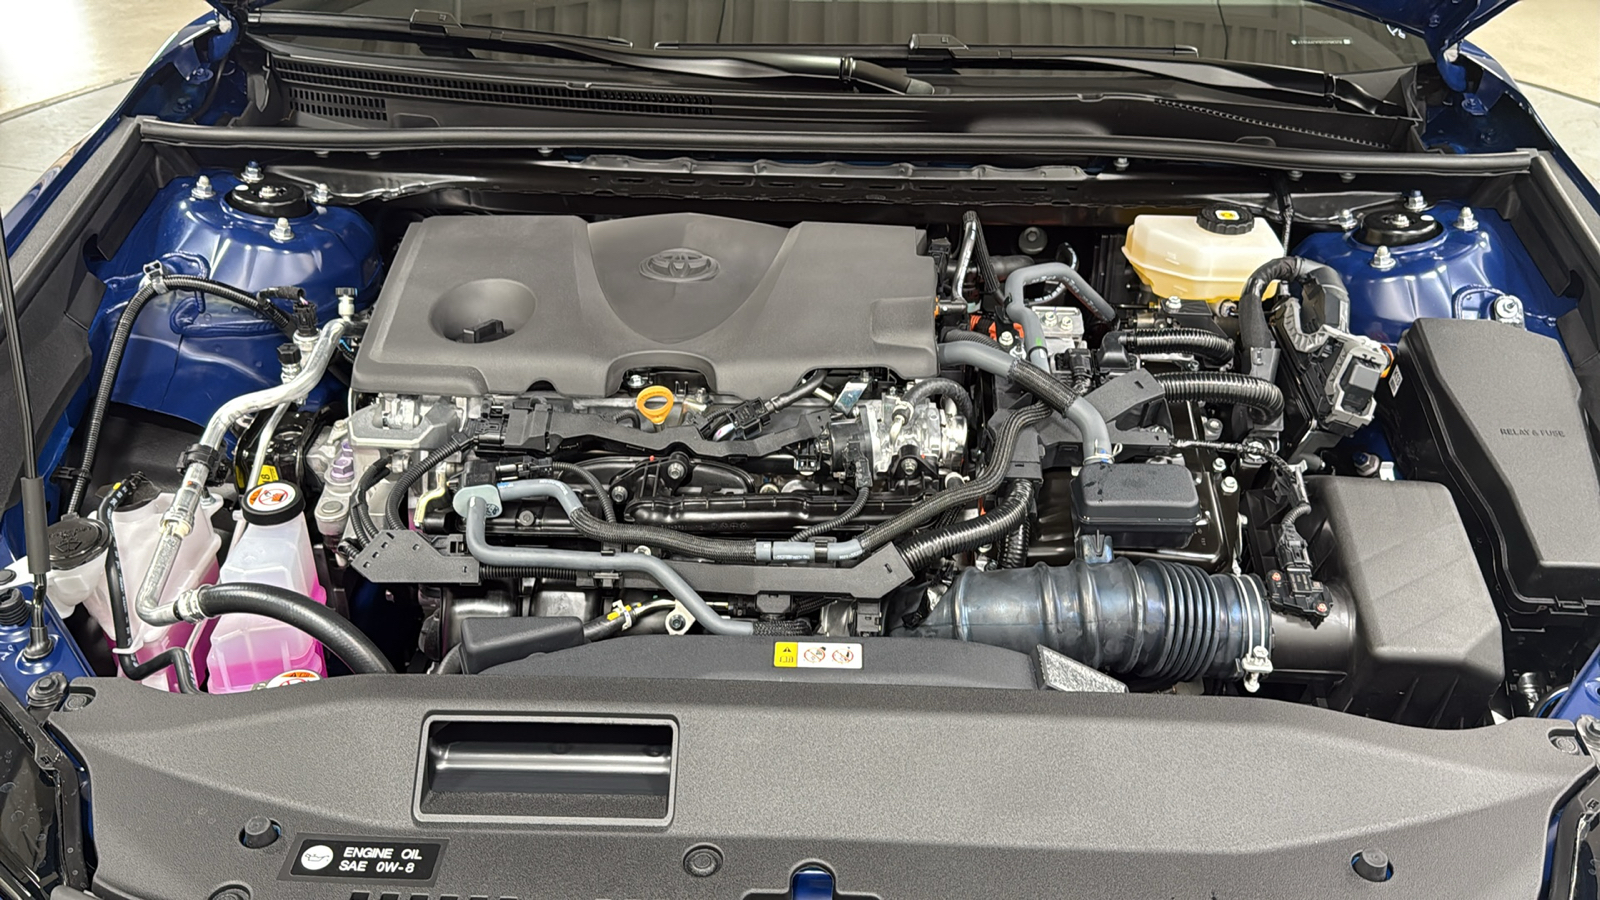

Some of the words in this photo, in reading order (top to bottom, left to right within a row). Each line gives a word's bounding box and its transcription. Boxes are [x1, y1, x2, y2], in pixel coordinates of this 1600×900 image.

[1500, 428, 1529, 436] RELAY
[344, 847, 393, 858] ENGINE
[401, 849, 422, 860] OIL
[338, 860, 368, 871] SAE
[376, 862, 415, 873] 0W-8
